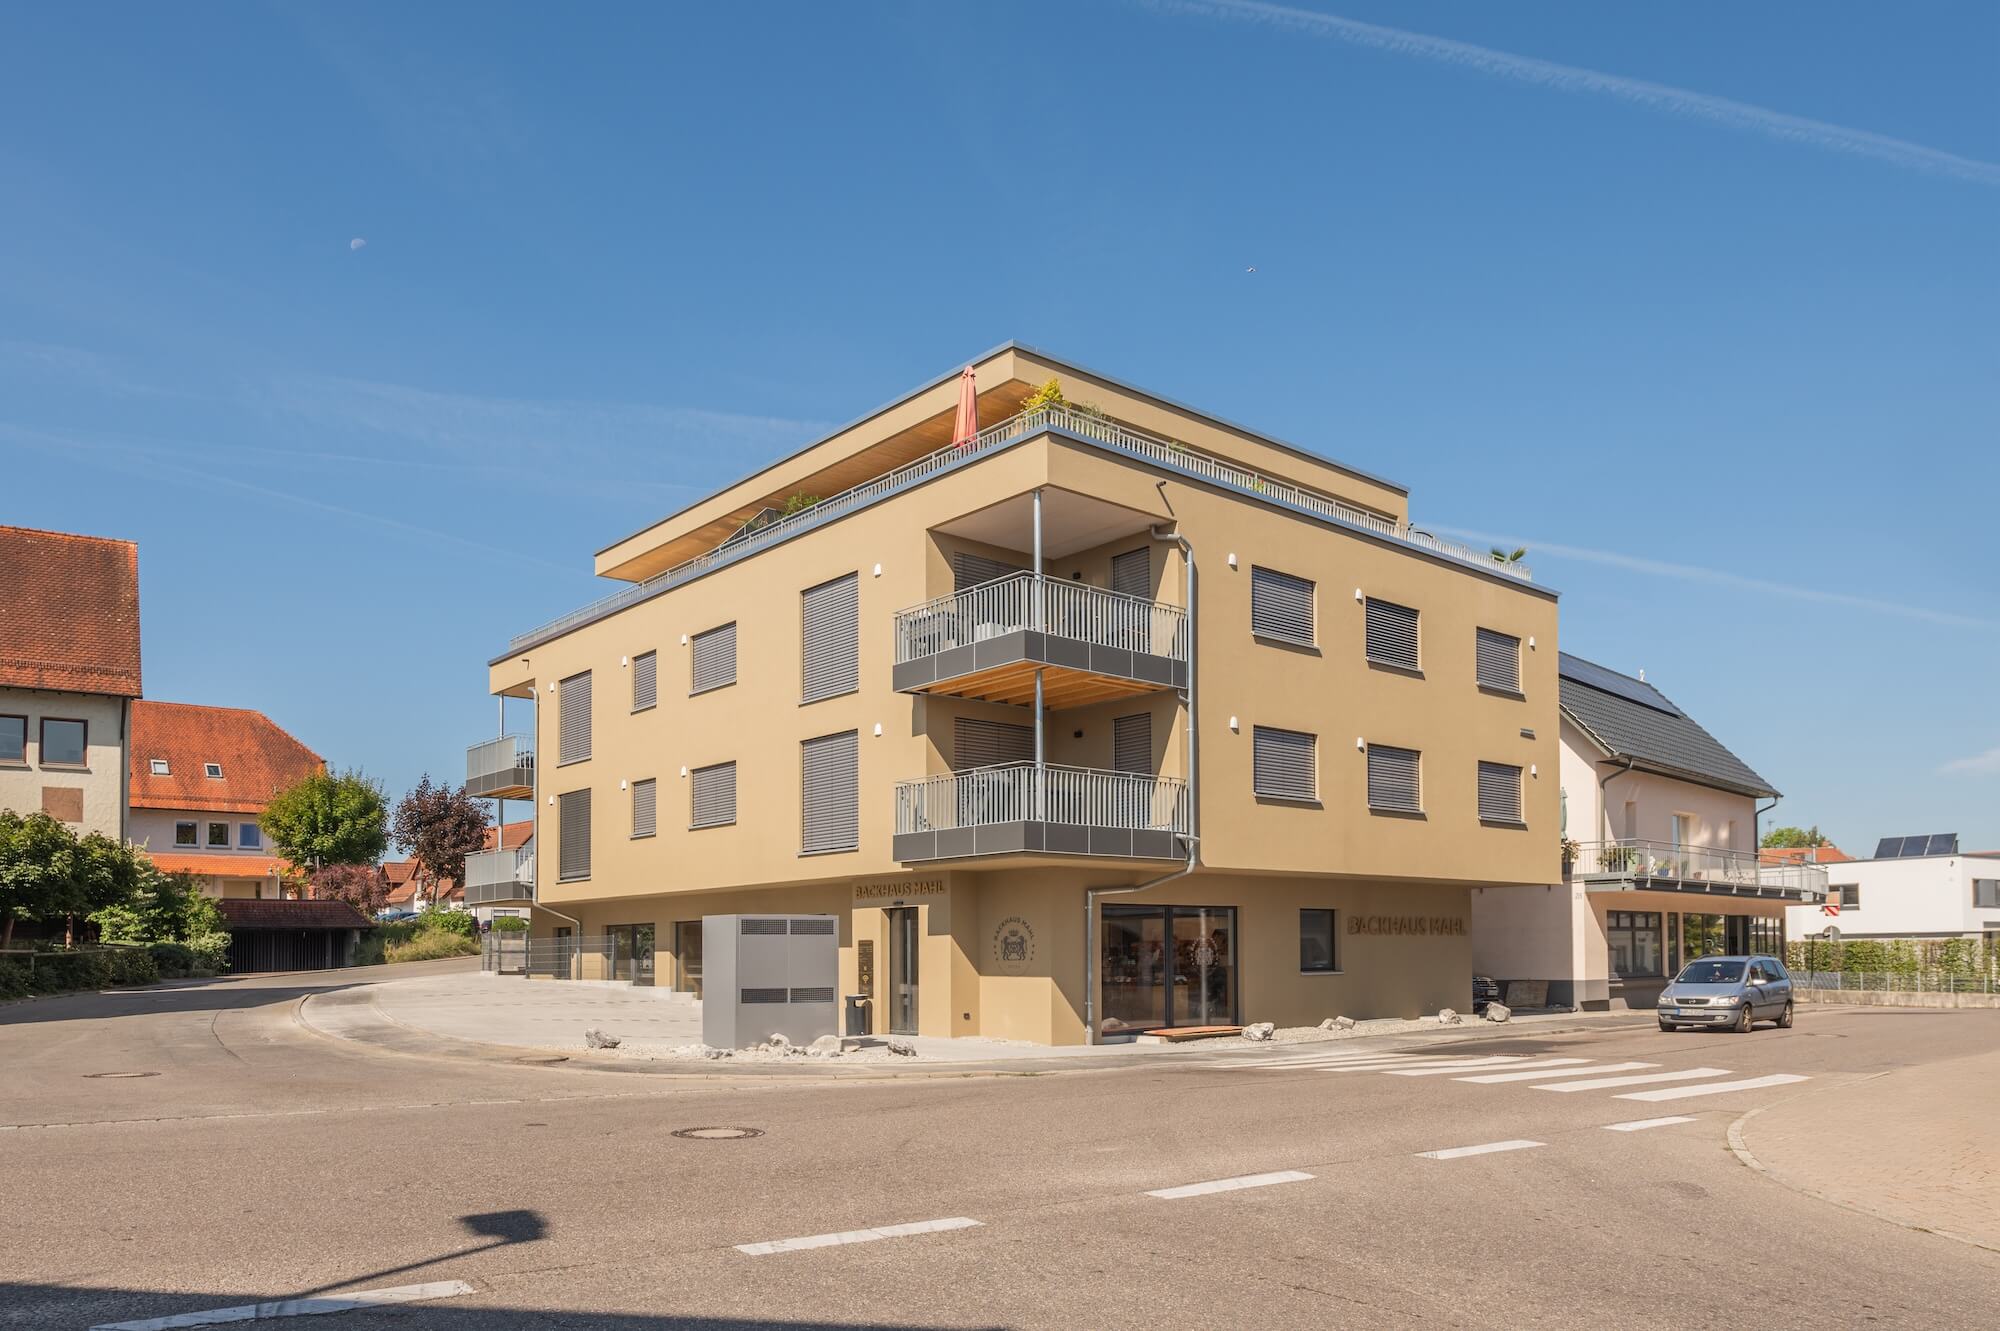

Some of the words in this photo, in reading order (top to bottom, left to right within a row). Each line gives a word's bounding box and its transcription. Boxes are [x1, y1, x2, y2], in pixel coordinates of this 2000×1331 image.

[856, 882, 912, 900] BACKHAUS
[914, 880, 945, 896] MAHL
[1347, 915, 1427, 936] BACKHAUS
[1429, 917, 1467, 936] MAHL
